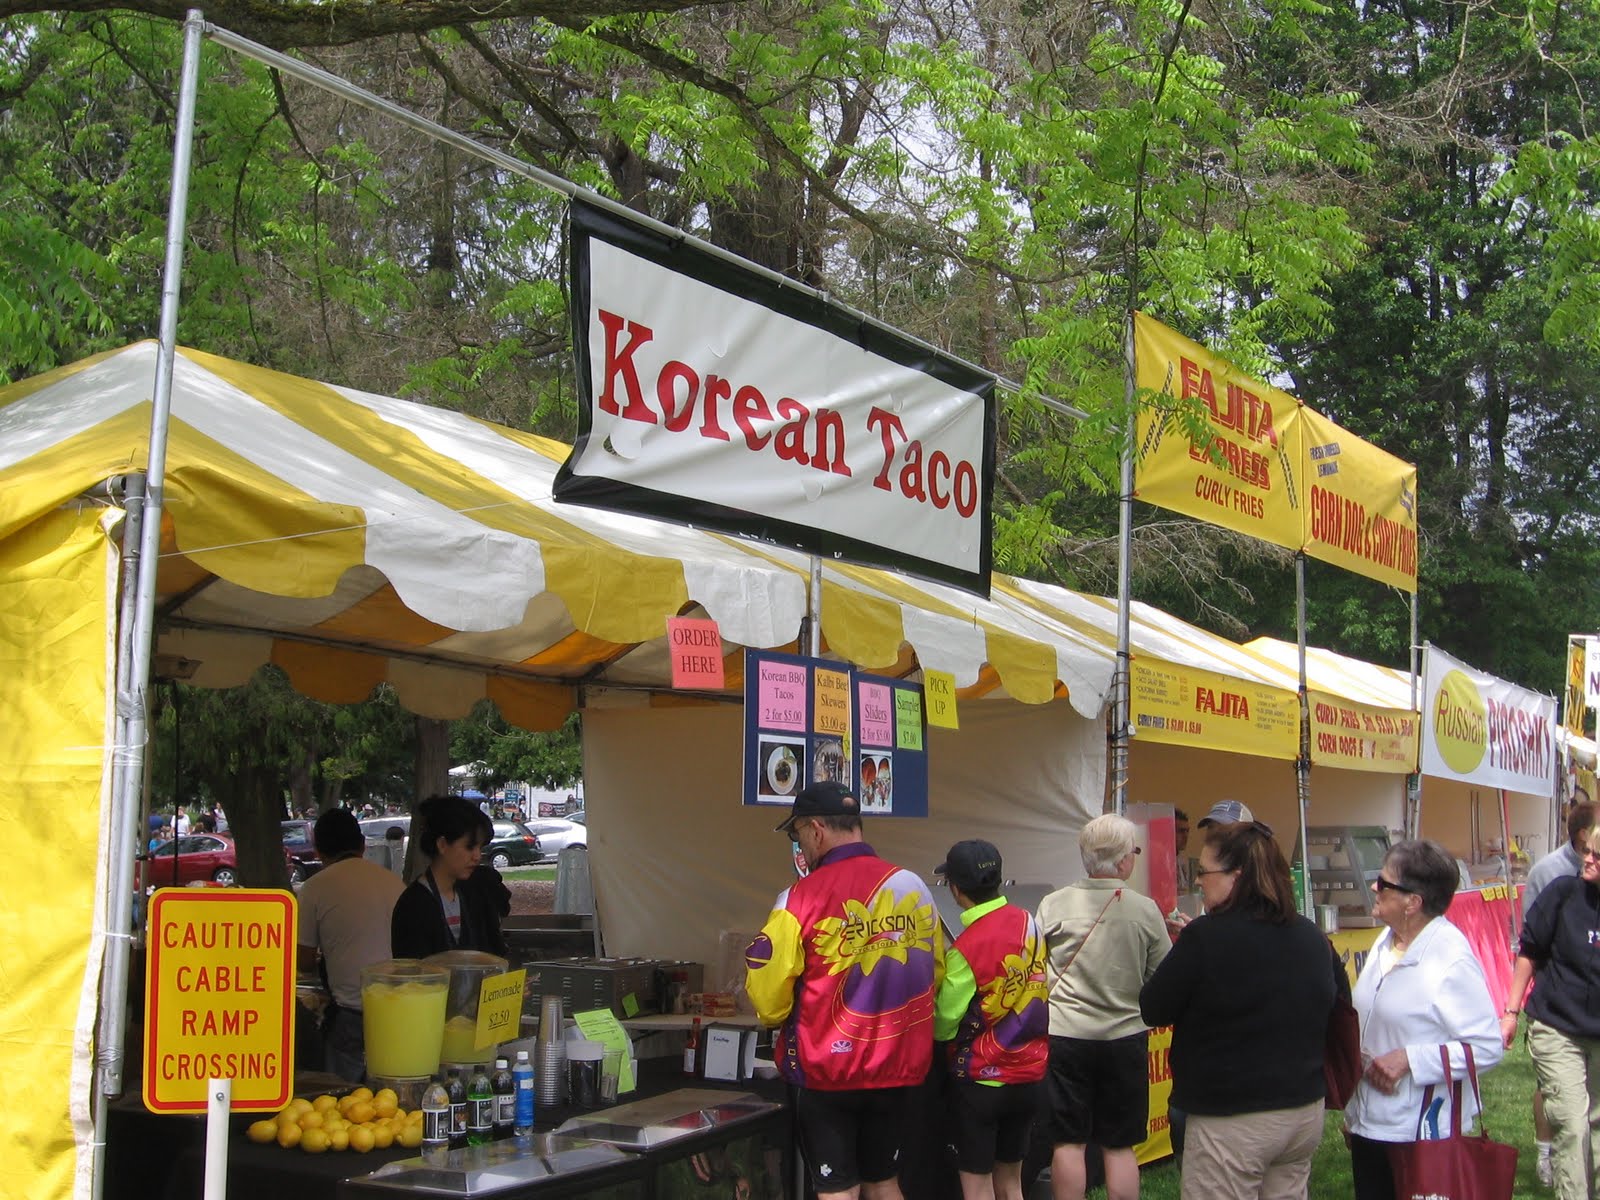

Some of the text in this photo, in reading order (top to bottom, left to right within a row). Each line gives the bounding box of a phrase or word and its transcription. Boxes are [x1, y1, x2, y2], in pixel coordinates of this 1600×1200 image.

[1180, 355, 1279, 450] FAJITA
[599, 308, 978, 518] Korean Taco
[1141, 420, 1156, 459] FRESH
[1195, 474, 1264, 519] CURLY FRIES
[1311, 484, 1343, 548] CORN
[1343, 498, 1364, 556] DOG
[1364, 516, 1371, 559] &
[1372, 512, 1399, 569] CURLY
[673, 628, 719, 647] ORDER
[681, 655, 717, 673] HERE
[761, 669, 805, 686] Korean BBQ
[817, 674, 834, 688] Kalbi
[930, 678, 948, 694] PICK
[774, 687, 794, 700] Tacos
[821, 694, 846, 708] Skewers
[1195, 686, 1250, 721] FAJITA
[766, 708, 802, 721] 2 for $5.00
[865, 704, 887, 720] Sliders
[897, 695, 920, 715] Sampler
[935, 700, 946, 715] UP
[821, 715, 839, 729] $3.00
[1315, 702, 1338, 726] CURLY
[1340, 708, 1360, 730] FRIES
[1436, 689, 1484, 746] Russian
[862, 728, 866, 739] 2
[867, 728, 875, 740] for
[1317, 731, 1337, 754] CORN
[1339, 735, 1357, 758] DOGS
[163, 922, 281, 949] CAUTION
[846, 915, 916, 941] ERICKSON
[176, 966, 266, 992] CABLE
[482, 982, 521, 1003] Lemonade
[182, 1009, 259, 1036] RAMP
[489, 1009, 510, 1027] $2.50
[162, 1052, 276, 1080] CROSSING
[1150, 1116, 1168, 1134] FRESH
